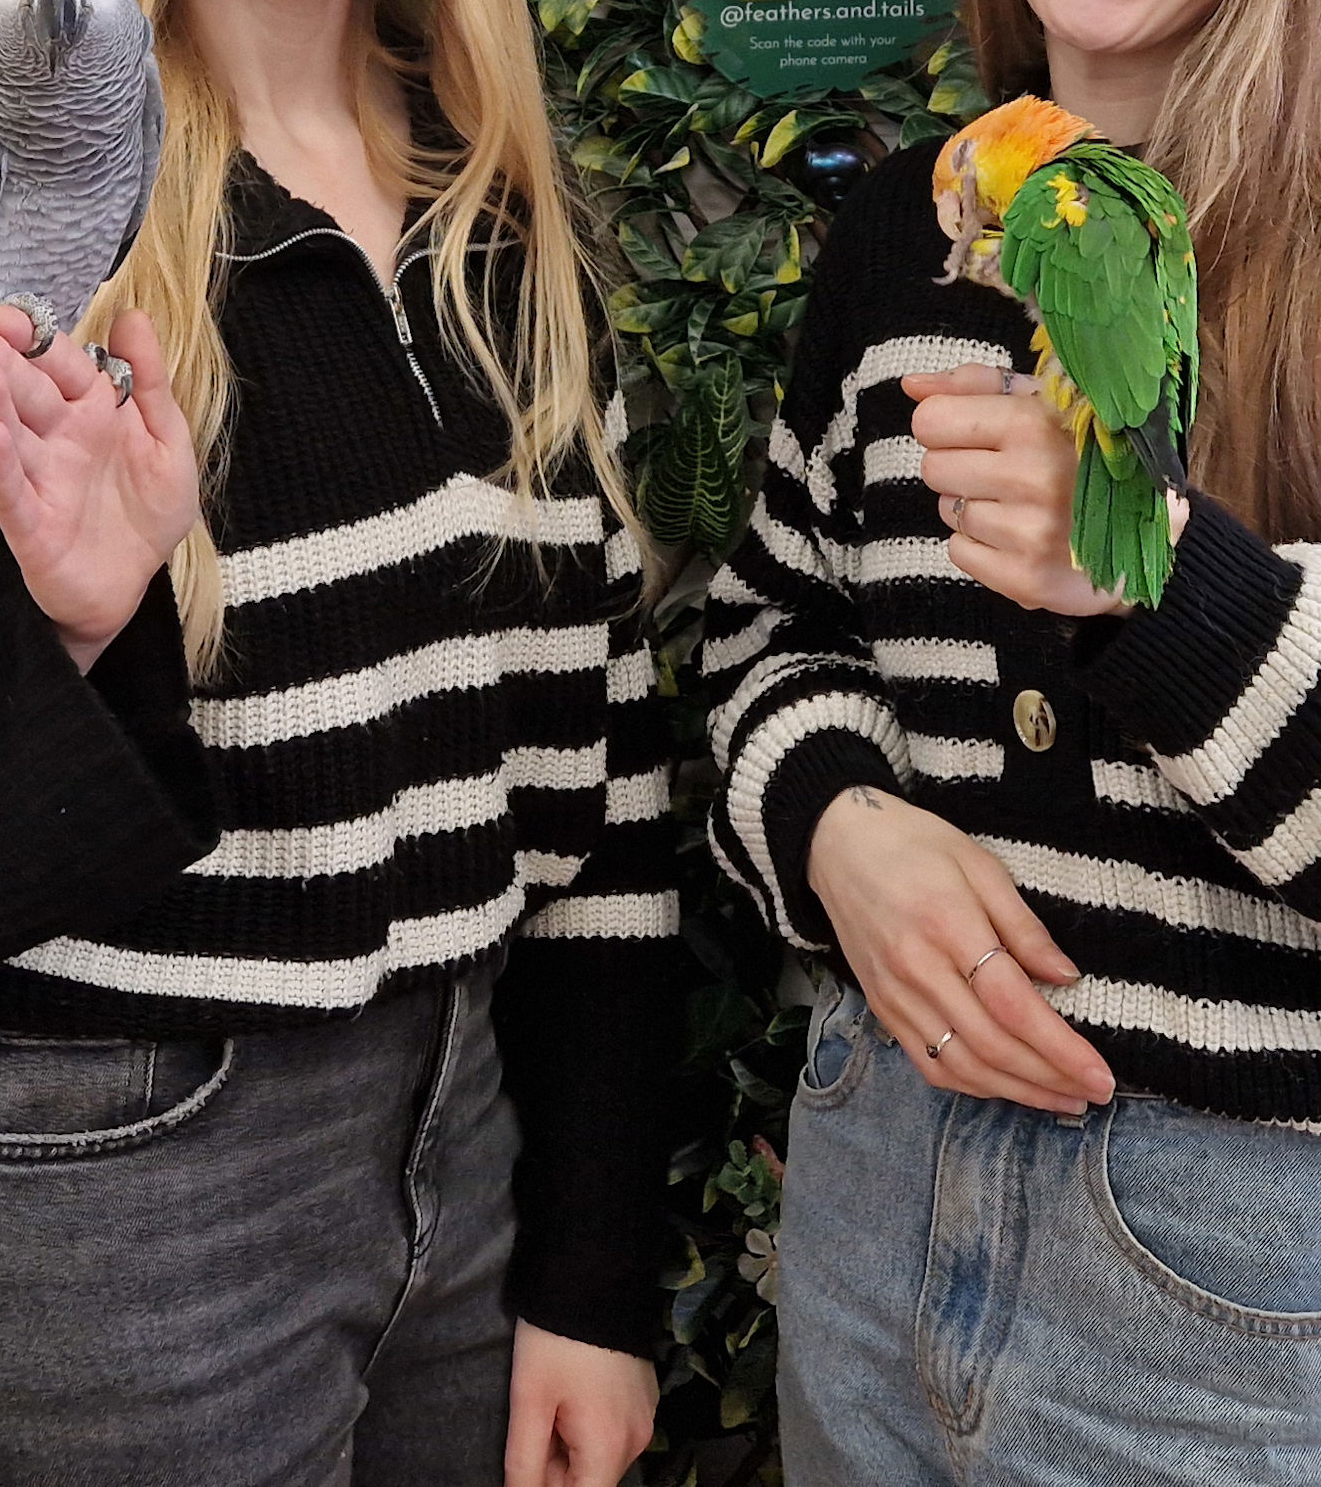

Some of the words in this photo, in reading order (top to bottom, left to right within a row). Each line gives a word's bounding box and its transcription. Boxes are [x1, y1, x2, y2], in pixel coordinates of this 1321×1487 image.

[749, 36, 780, 50] Scan
[784, 35, 803, 49] the
[807, 33, 837, 48] code
[841, 33, 866, 47] with
[870, 35, 896, 52] your
[779, 52, 818, 68] phone
[822, 54, 867, 66] camera
